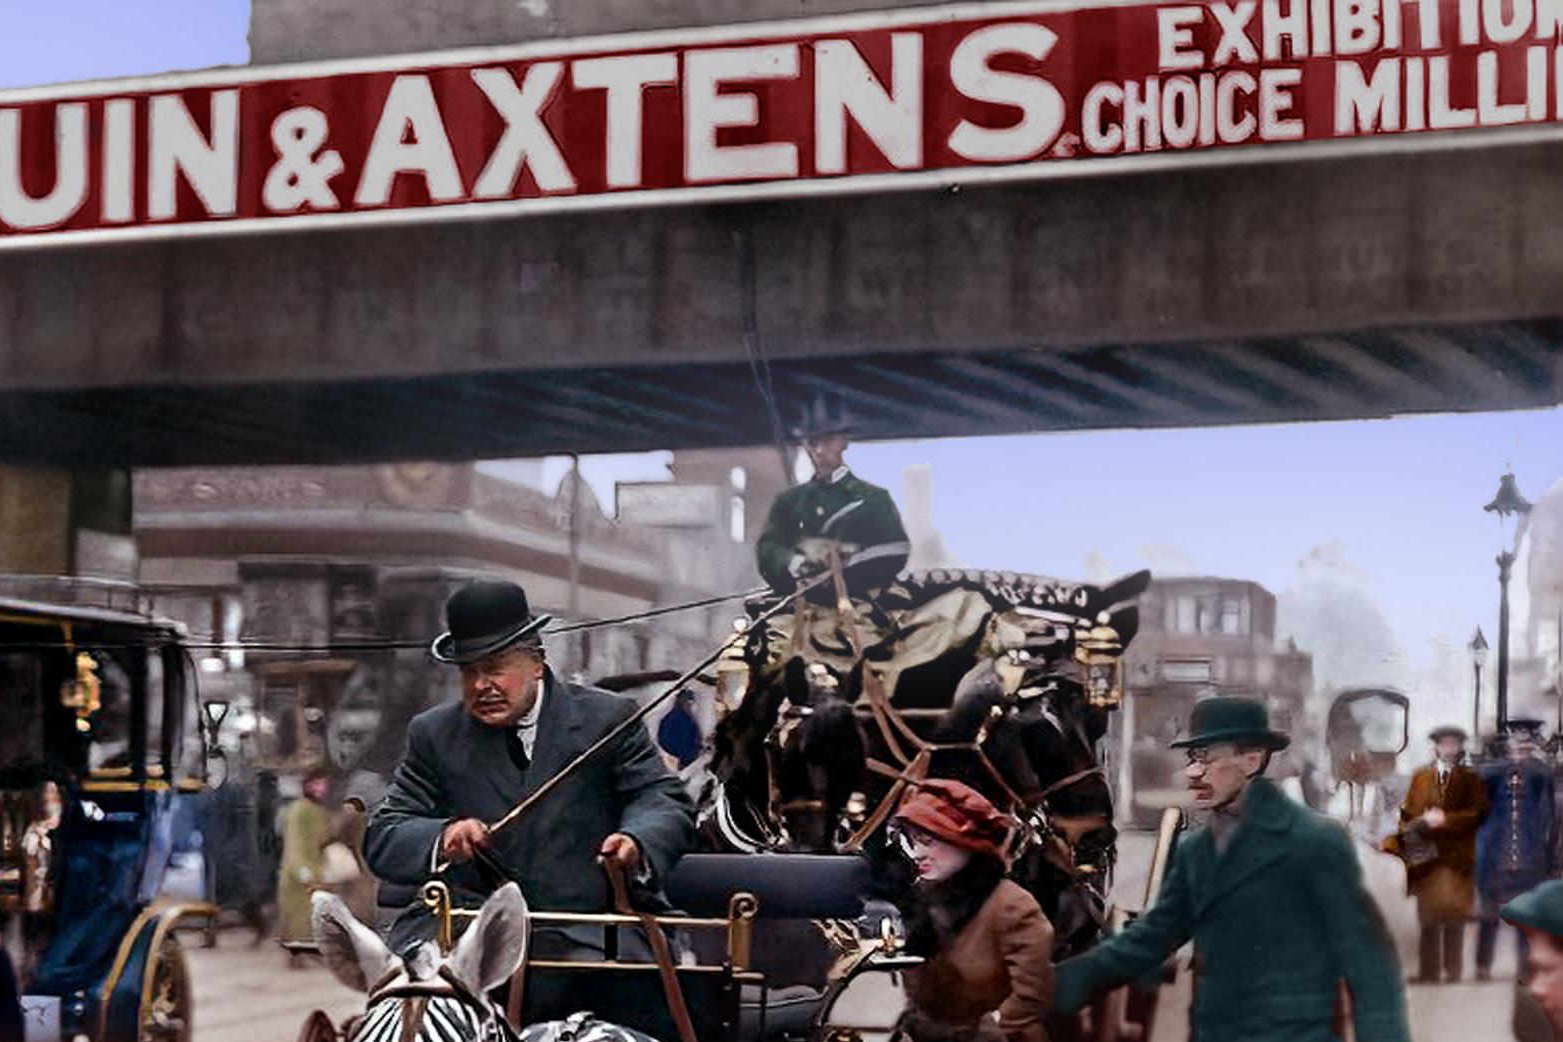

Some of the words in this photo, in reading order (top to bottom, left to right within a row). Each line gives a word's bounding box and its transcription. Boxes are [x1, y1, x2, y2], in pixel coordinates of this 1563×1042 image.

[1081, 67, 1305, 154] CHOICE
[1333, 43, 1563, 136] MILLI
[263, 106, 344, 214] &
